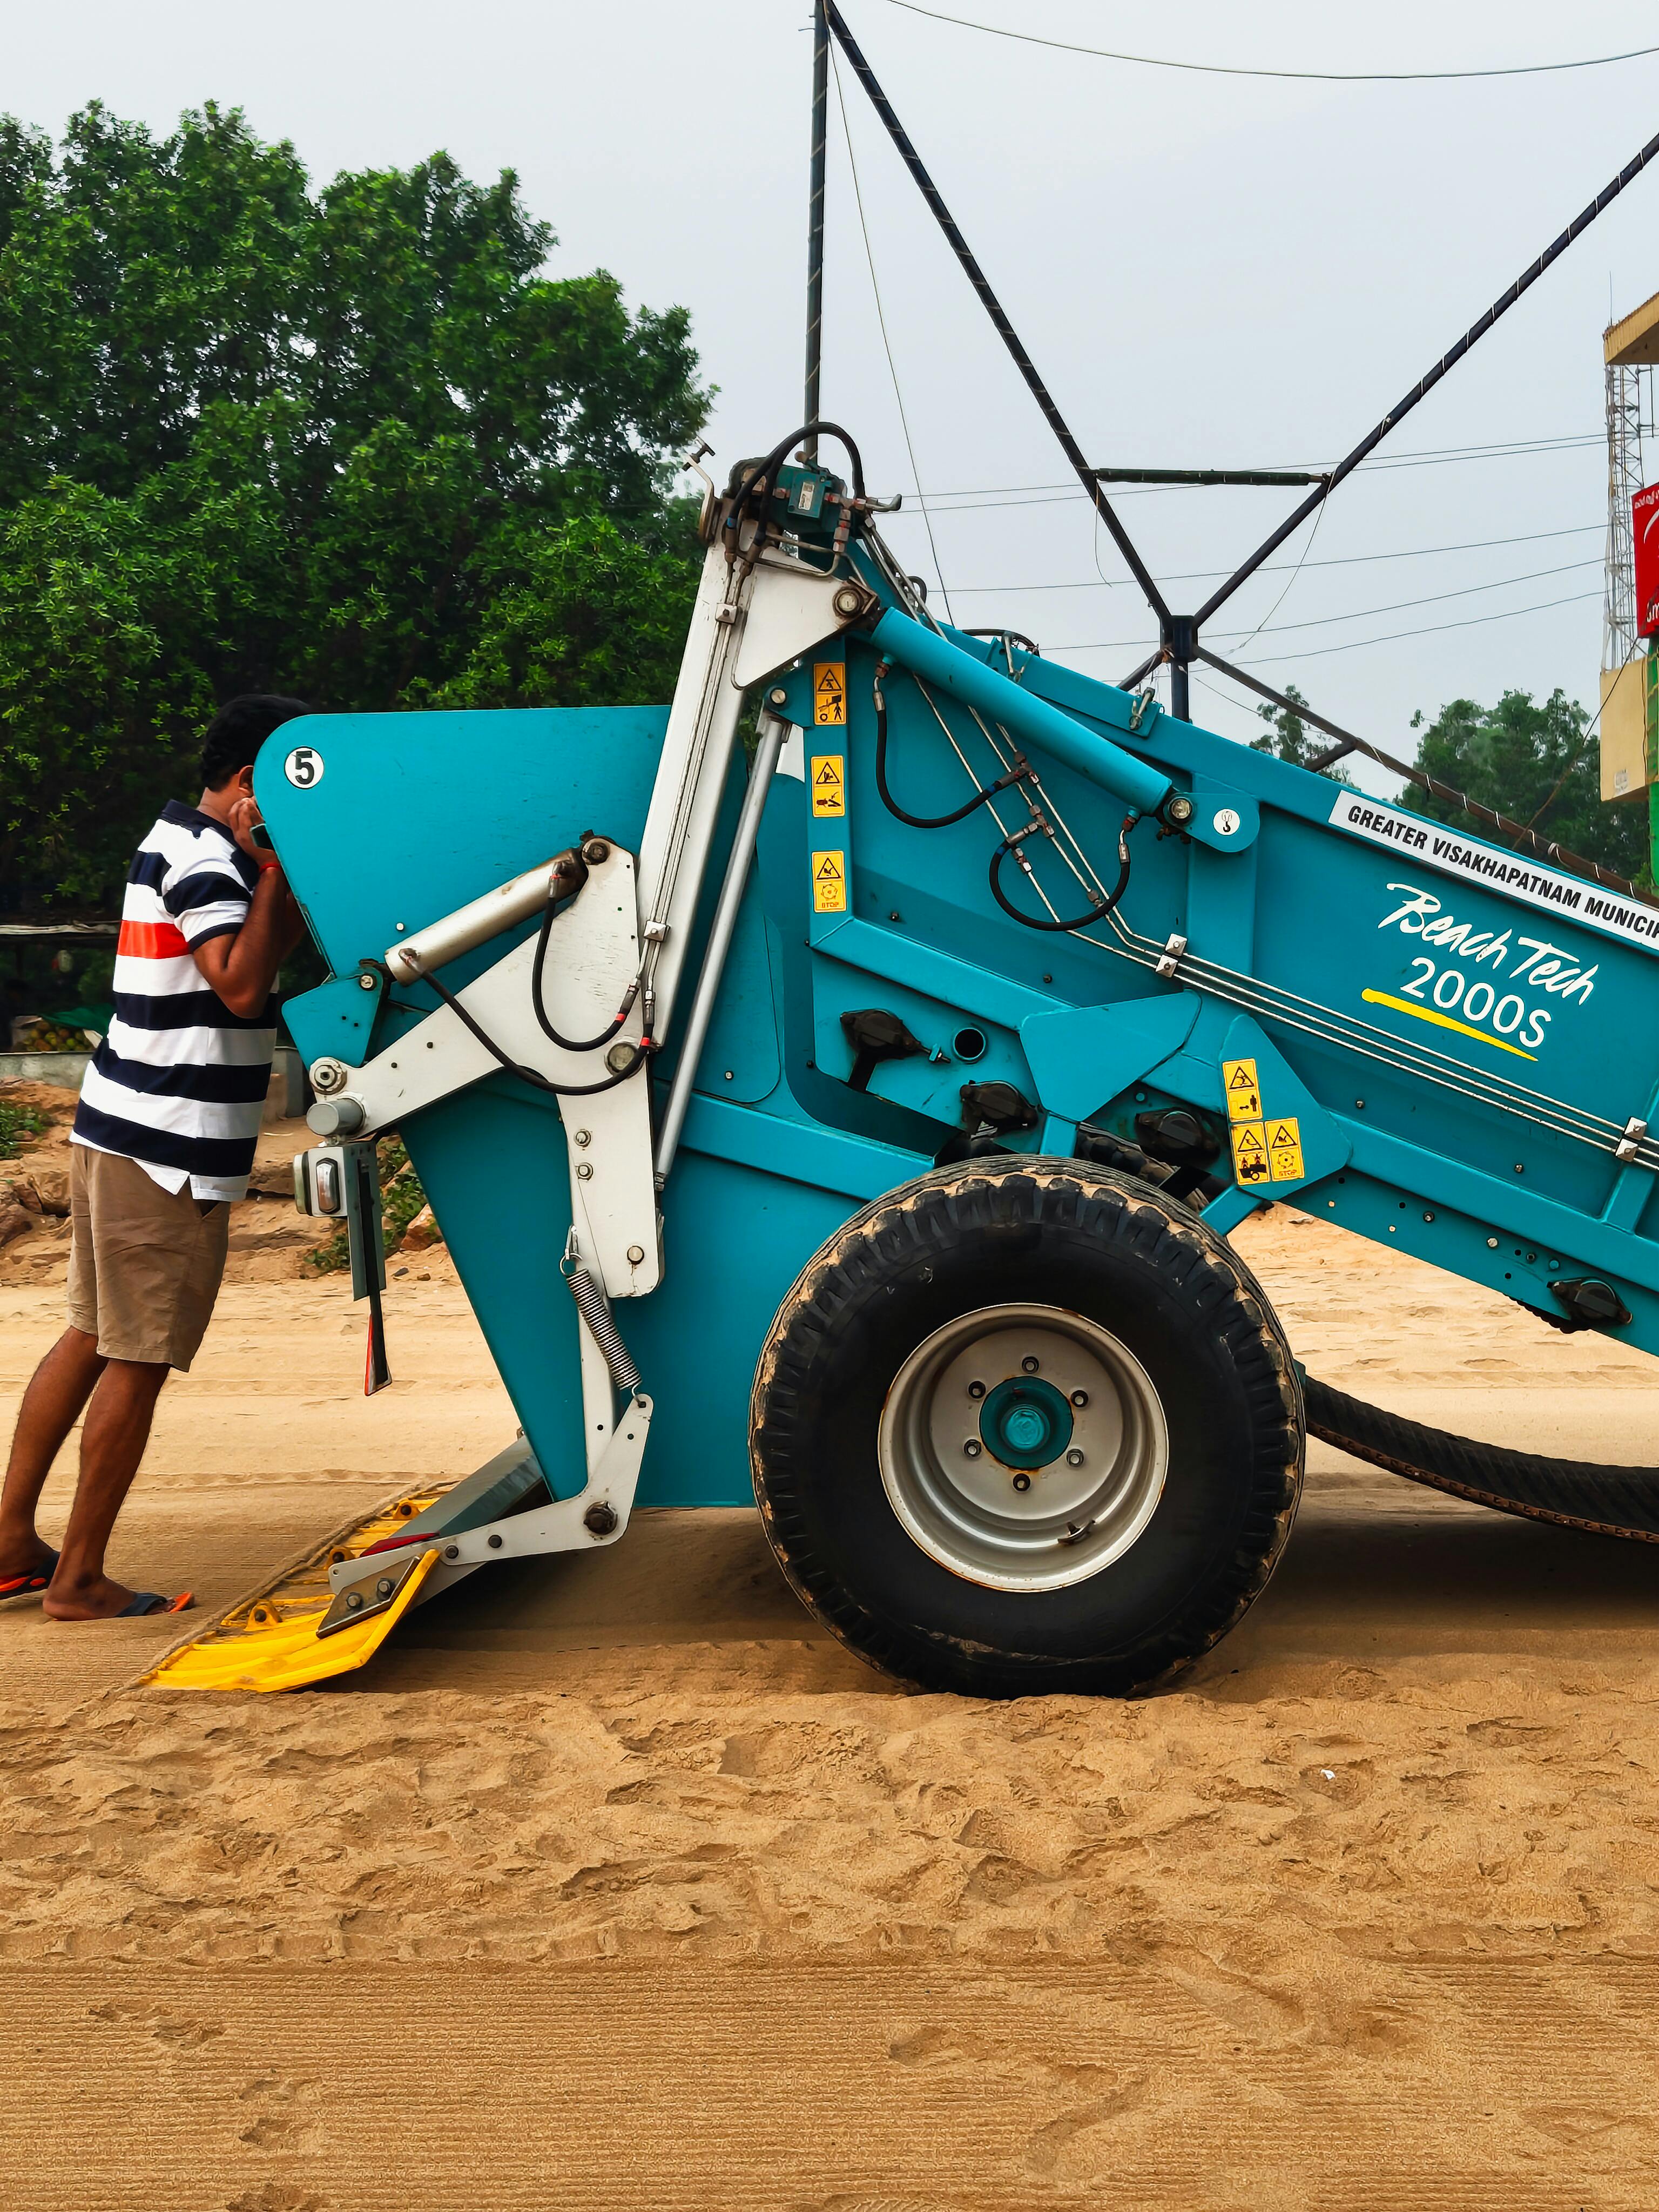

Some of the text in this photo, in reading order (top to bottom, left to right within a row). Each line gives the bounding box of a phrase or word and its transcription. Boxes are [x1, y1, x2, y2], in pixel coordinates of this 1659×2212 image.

[295, 750, 315, 785] 5
[1348, 805, 1428, 851] GREATER
[1432, 837, 1582, 909] VISAKHAPATNAM
[1378, 882, 1599, 1006] Beach Tech
[1400, 957, 1552, 1048] 2000S
